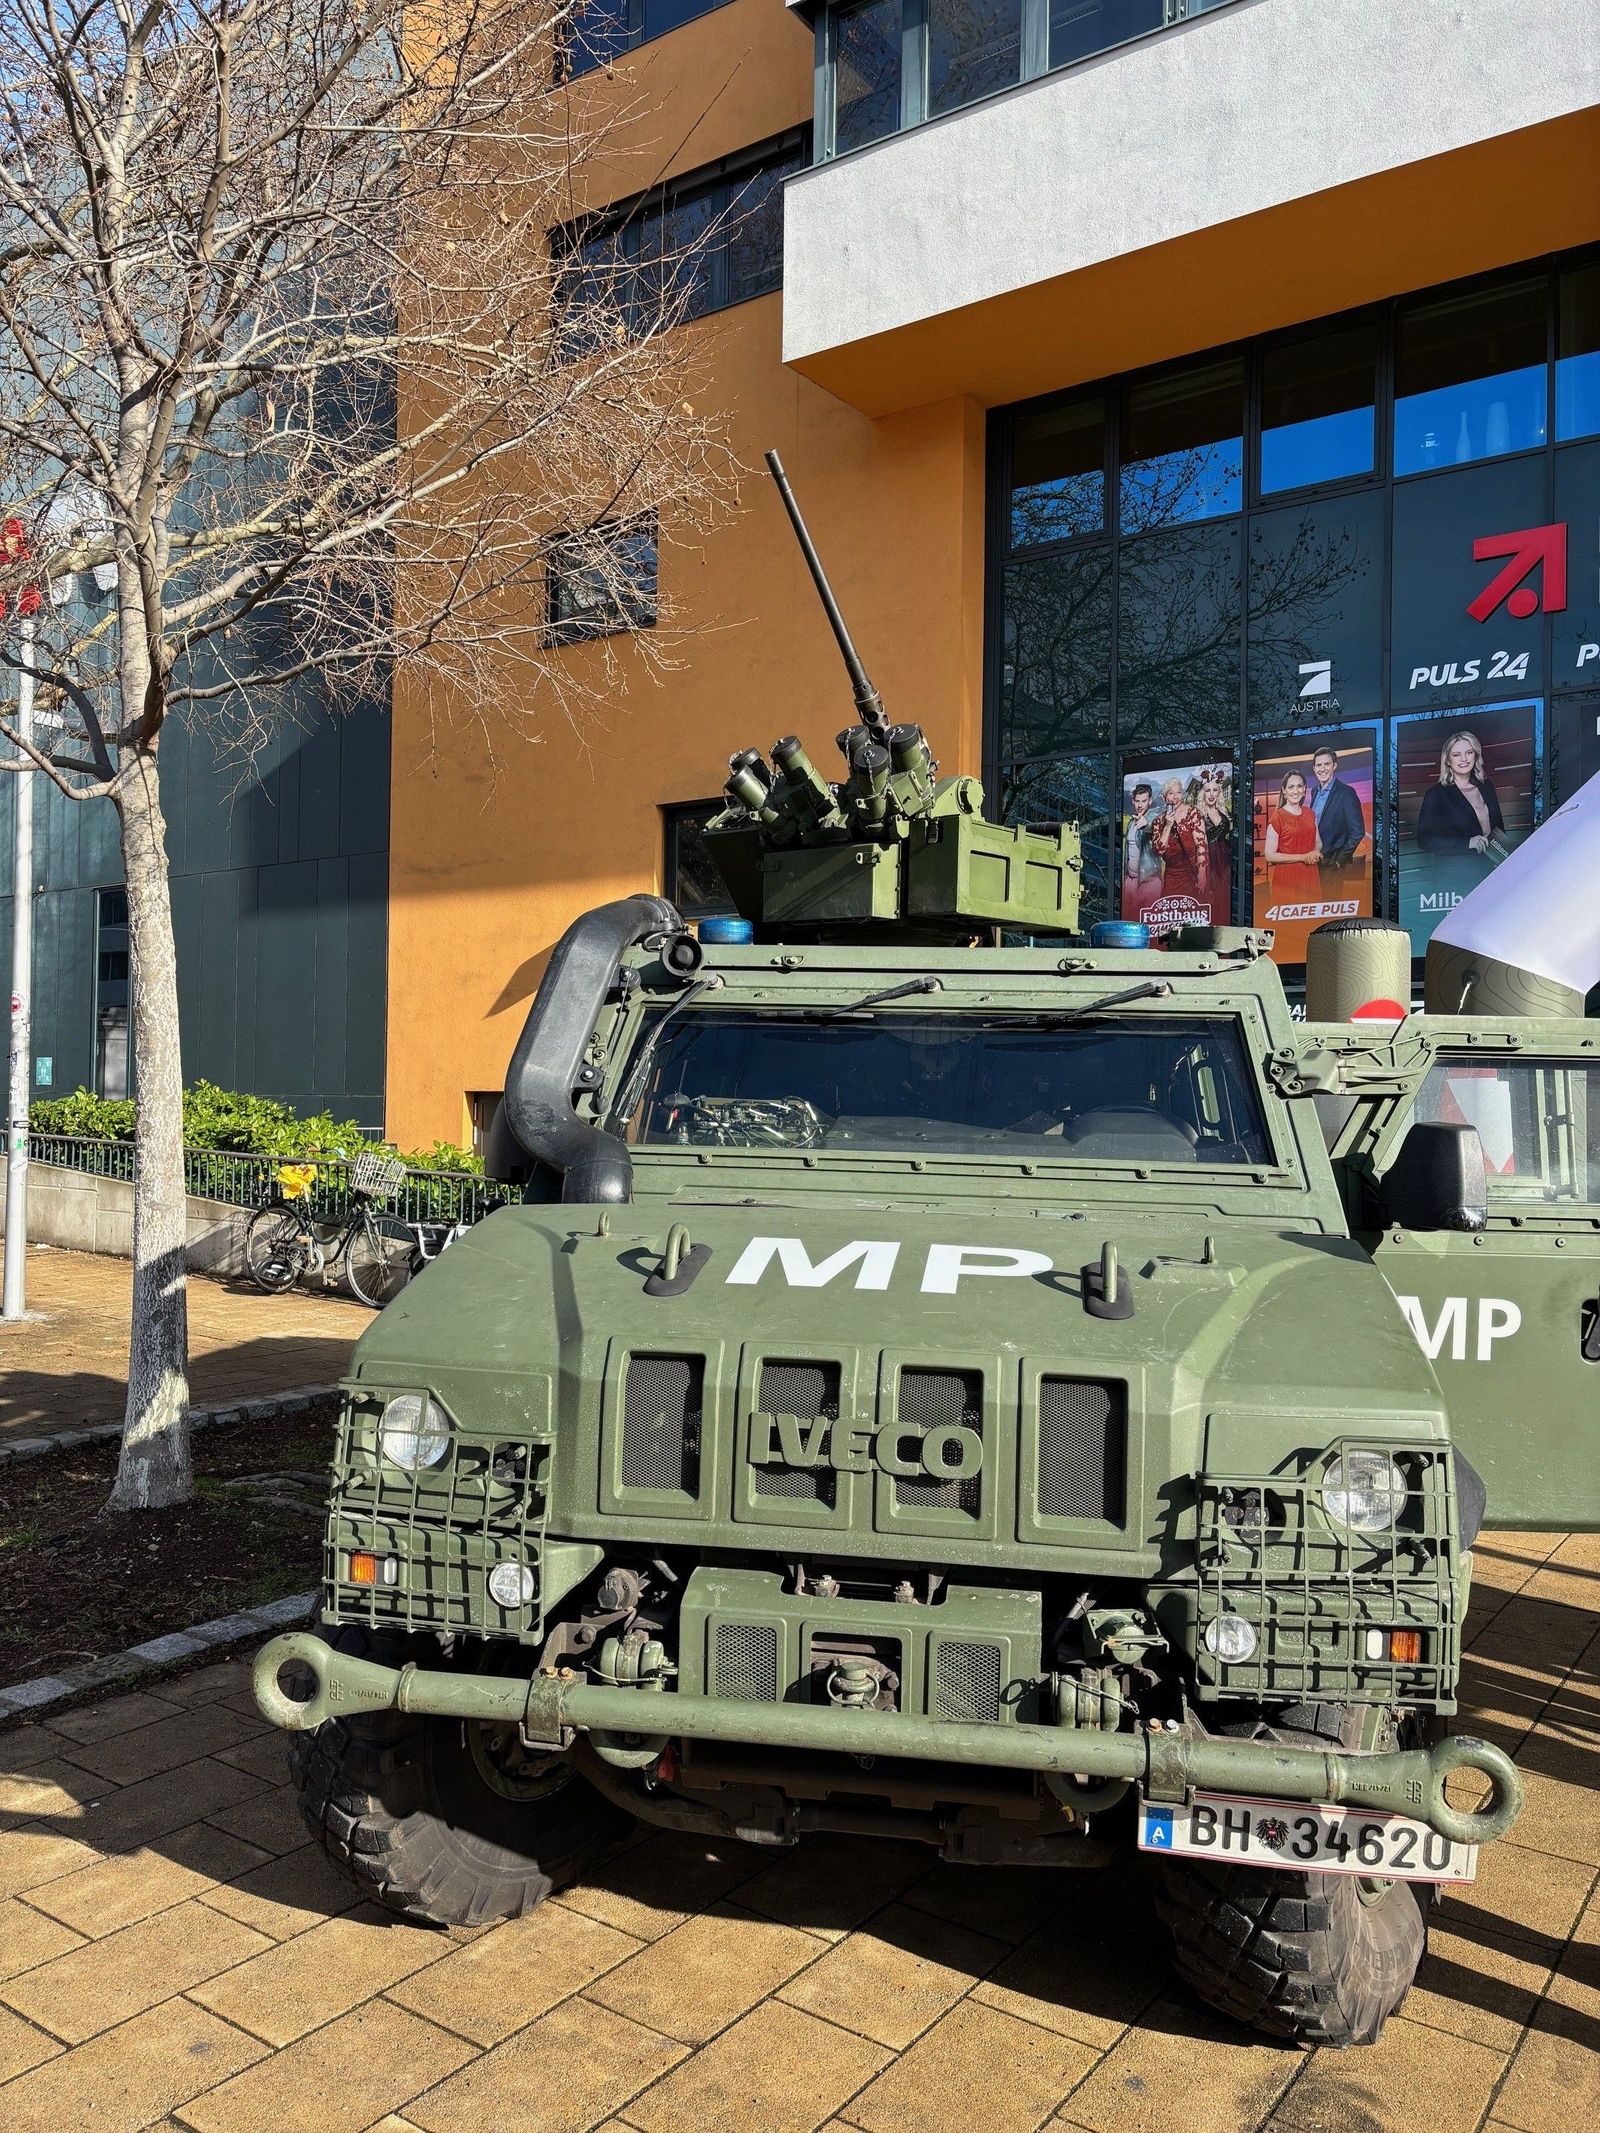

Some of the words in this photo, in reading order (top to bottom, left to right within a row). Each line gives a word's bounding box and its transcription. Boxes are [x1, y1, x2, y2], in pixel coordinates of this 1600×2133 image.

[1409, 659, 1481, 690] PULS
[1487, 650, 1531, 680] 24
[1576, 643, 1600, 667] P
[1289, 698, 1340, 714] AUSTRIA
[1143, 909, 1208, 923] Forsthaus
[1281, 905, 1317, 918] CAFE
[1321, 902, 1356, 915] PULS
[1420, 891, 1464, 909] Milb
[724, 1236, 1055, 1295] MP
[1397, 1295, 1522, 1361] MP
[747, 1411, 984, 1481] IVECO
[1152, 1826, 1165, 1841] A
[1190, 1805, 1250, 1852] BH
[1292, 1816, 1451, 1872] 34620
